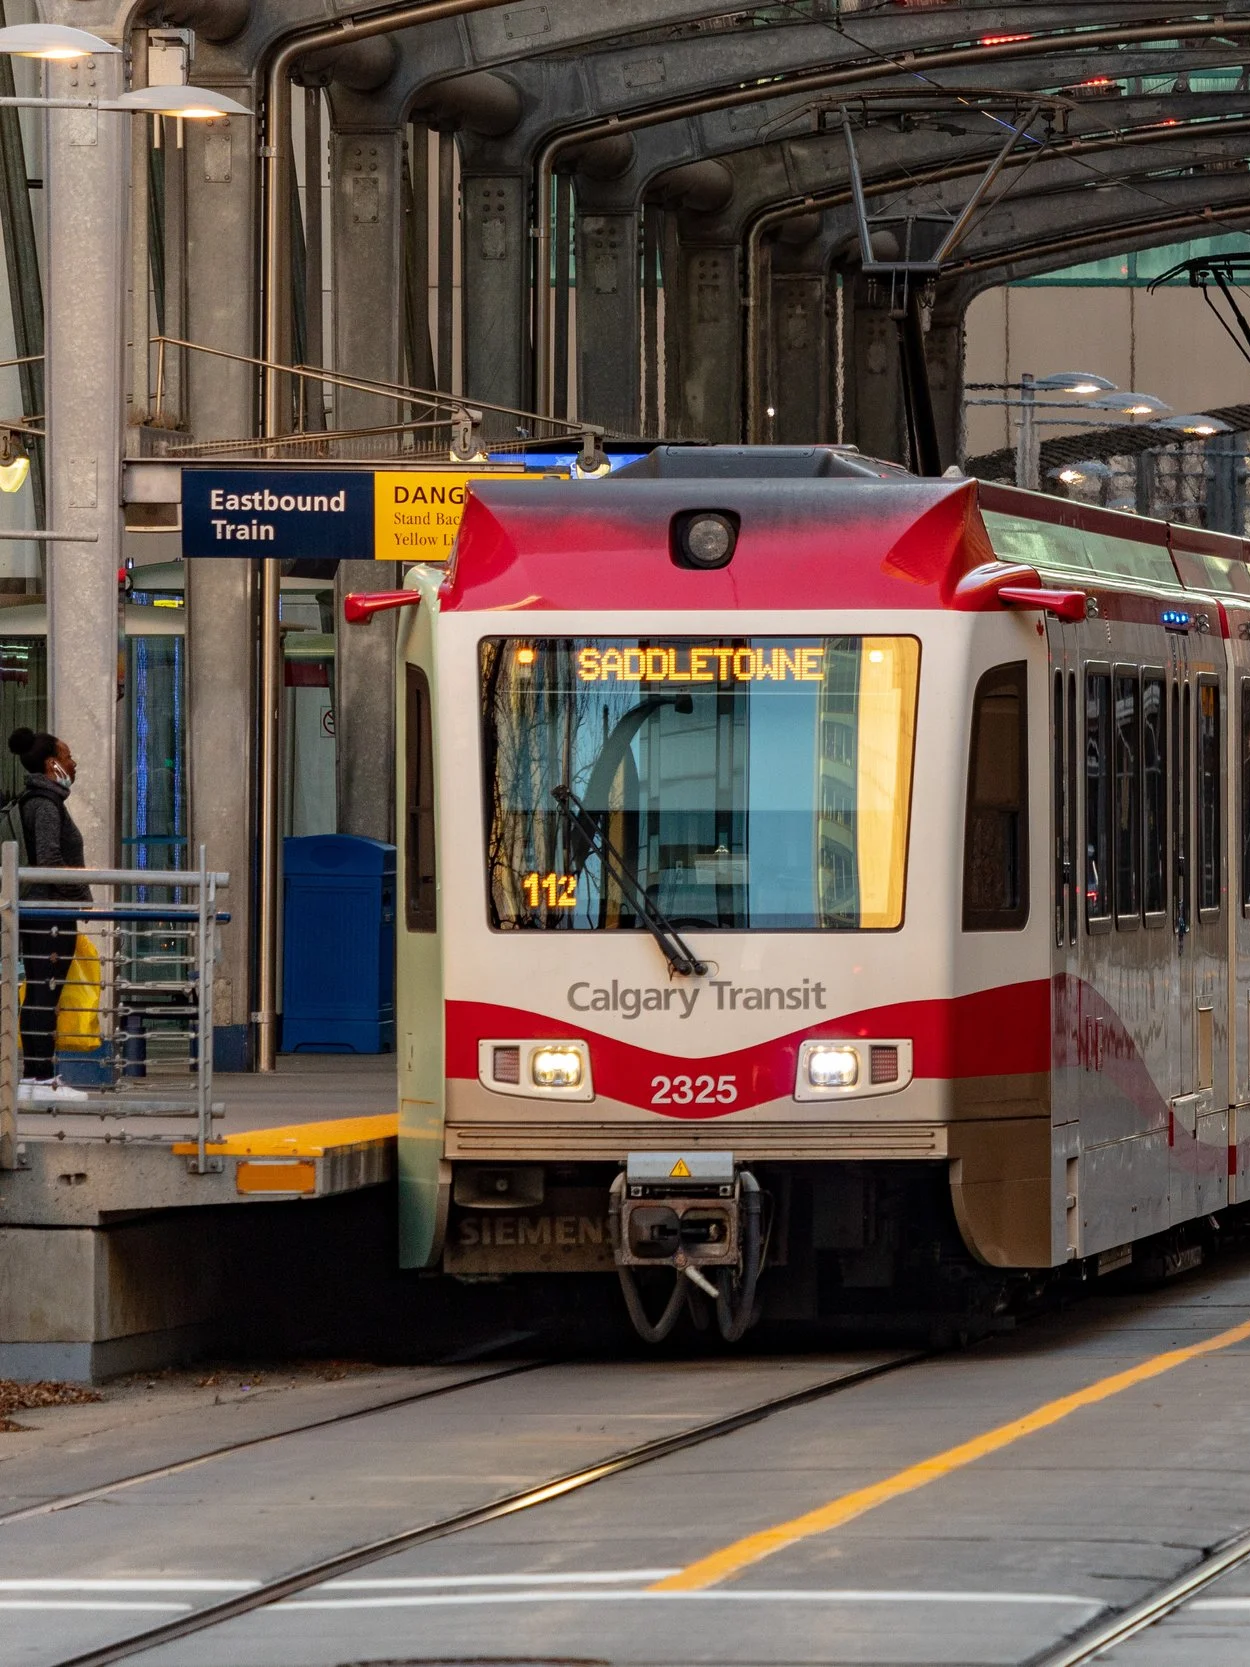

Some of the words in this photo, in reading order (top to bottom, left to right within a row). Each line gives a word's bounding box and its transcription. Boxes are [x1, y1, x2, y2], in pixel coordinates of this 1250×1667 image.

[210, 489, 345, 512] Eastbound
[394, 486, 464, 504] DANG
[211, 519, 275, 540] Train
[394, 512, 430, 525] Stand
[394, 532, 438, 546] Yellow
[578, 647, 825, 682] SADDLETOWNE
[522, 872, 577, 907] 112
[567, 979, 700, 1020] Calgary
[709, 978, 827, 1011] Transit
[651, 1075, 738, 1104] 2325
